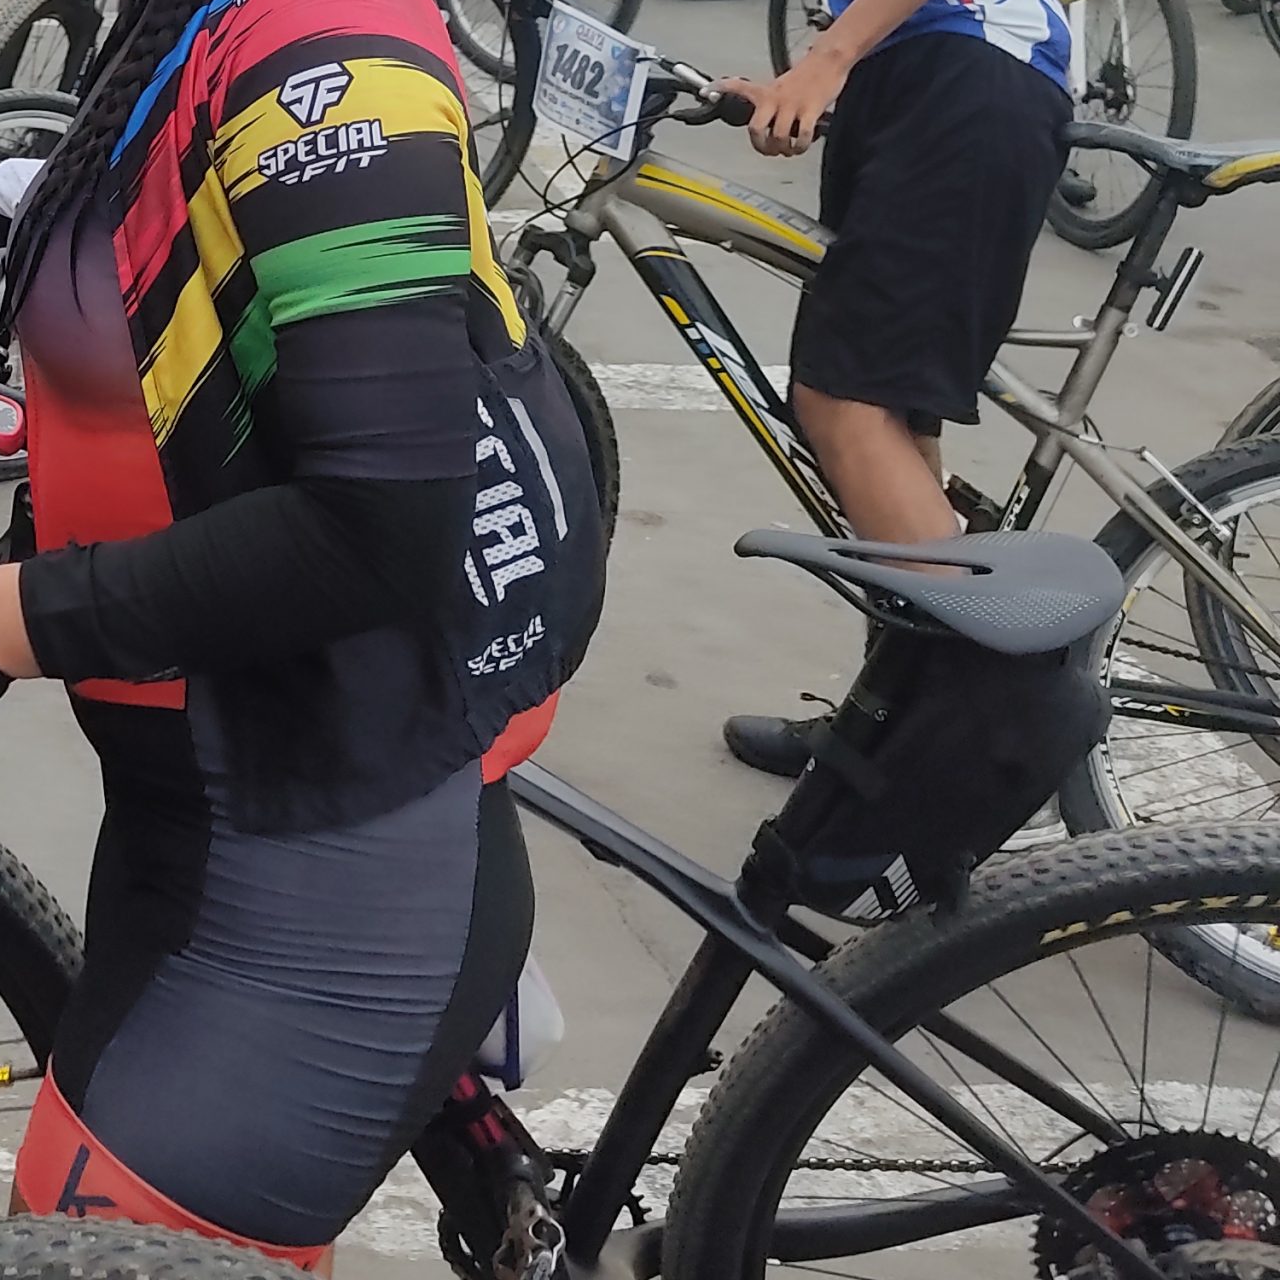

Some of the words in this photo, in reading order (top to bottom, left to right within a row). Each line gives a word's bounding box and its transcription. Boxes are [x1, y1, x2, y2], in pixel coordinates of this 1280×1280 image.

[550, 42, 606, 100] 1482
[257, 120, 388, 177] SPECIAL
[278, 149, 389, 186] FIT
